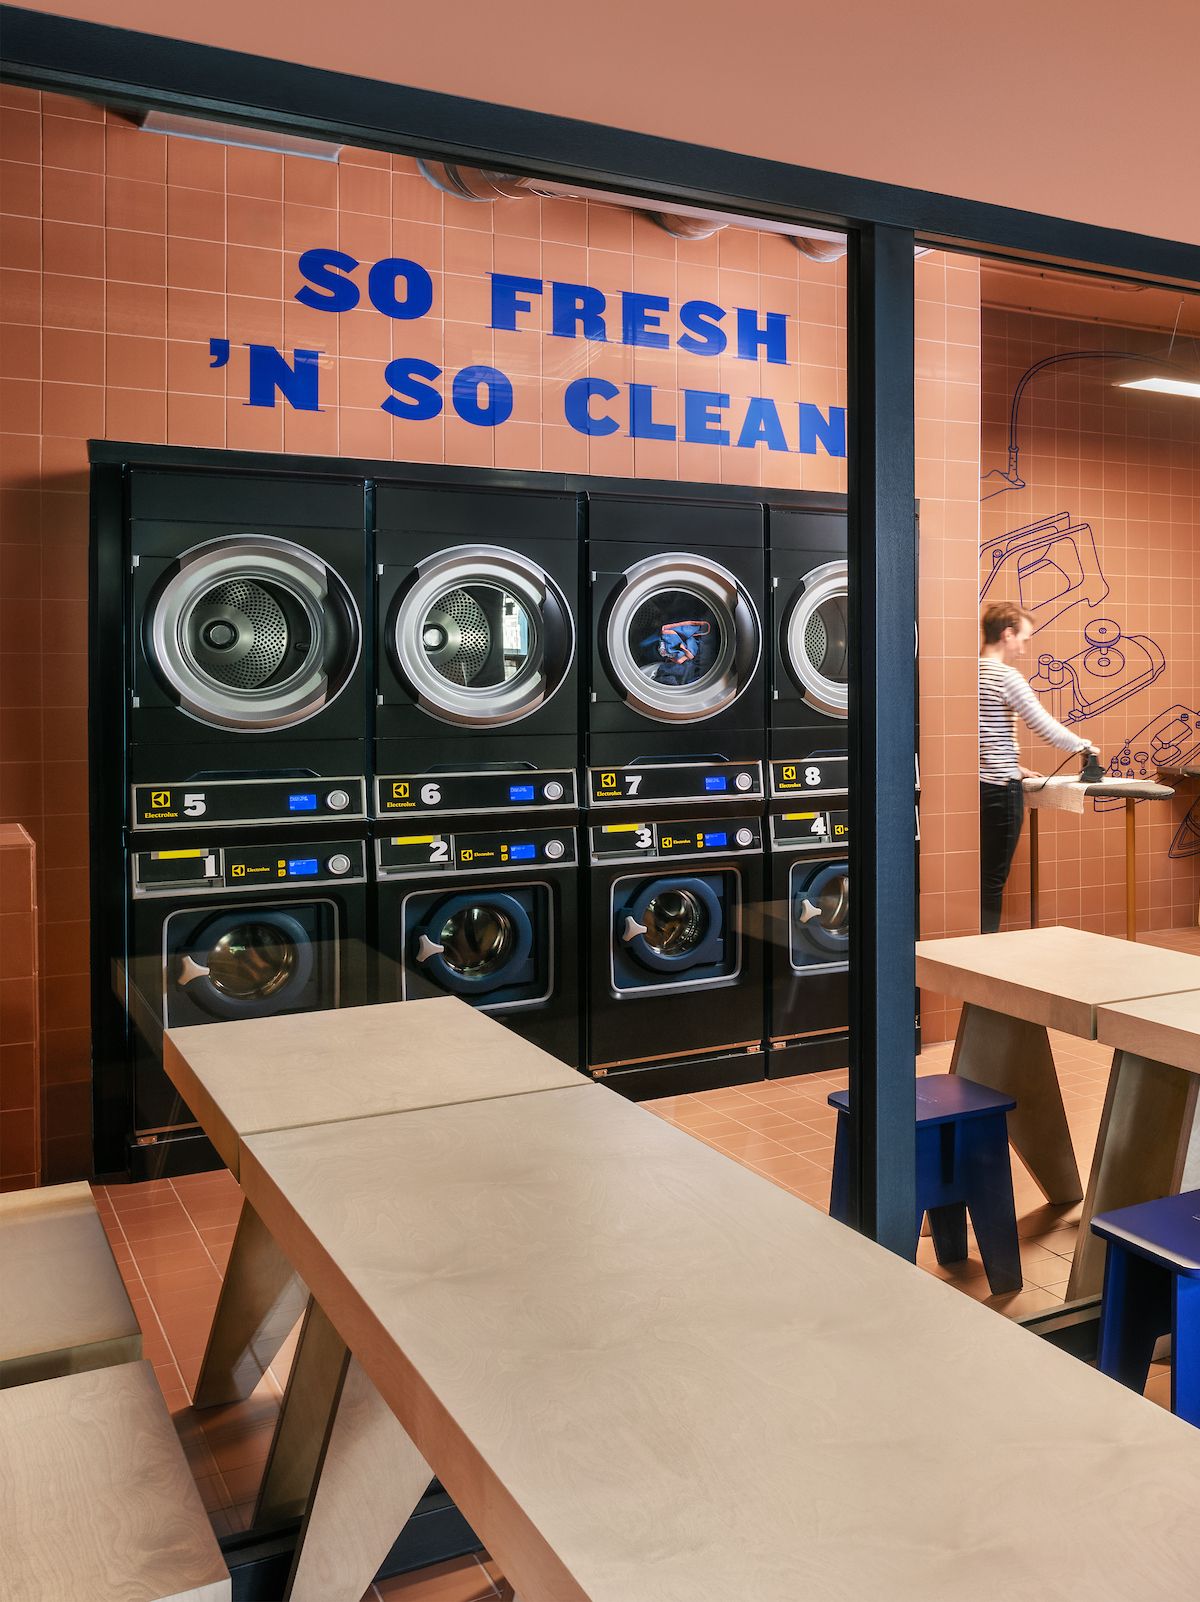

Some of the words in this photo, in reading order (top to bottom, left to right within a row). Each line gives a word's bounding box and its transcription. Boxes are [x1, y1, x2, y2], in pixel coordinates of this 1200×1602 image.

[294, 248, 433, 320] SO
[485, 271, 791, 366] FRESH
[381, 357, 514, 427] SO
[564, 377, 848, 458] CLEAN
[625, 775, 642, 795] 7
[804, 766, 821, 786] 8
[420, 783, 441, 805] 6
[144, 811, 179, 819] Electrolux
[183, 793, 207, 817] 5
[810, 817, 827, 835] 4
[635, 828, 652, 848] 3
[429, 841, 449, 862] 2
[203, 854, 218, 878] 1
